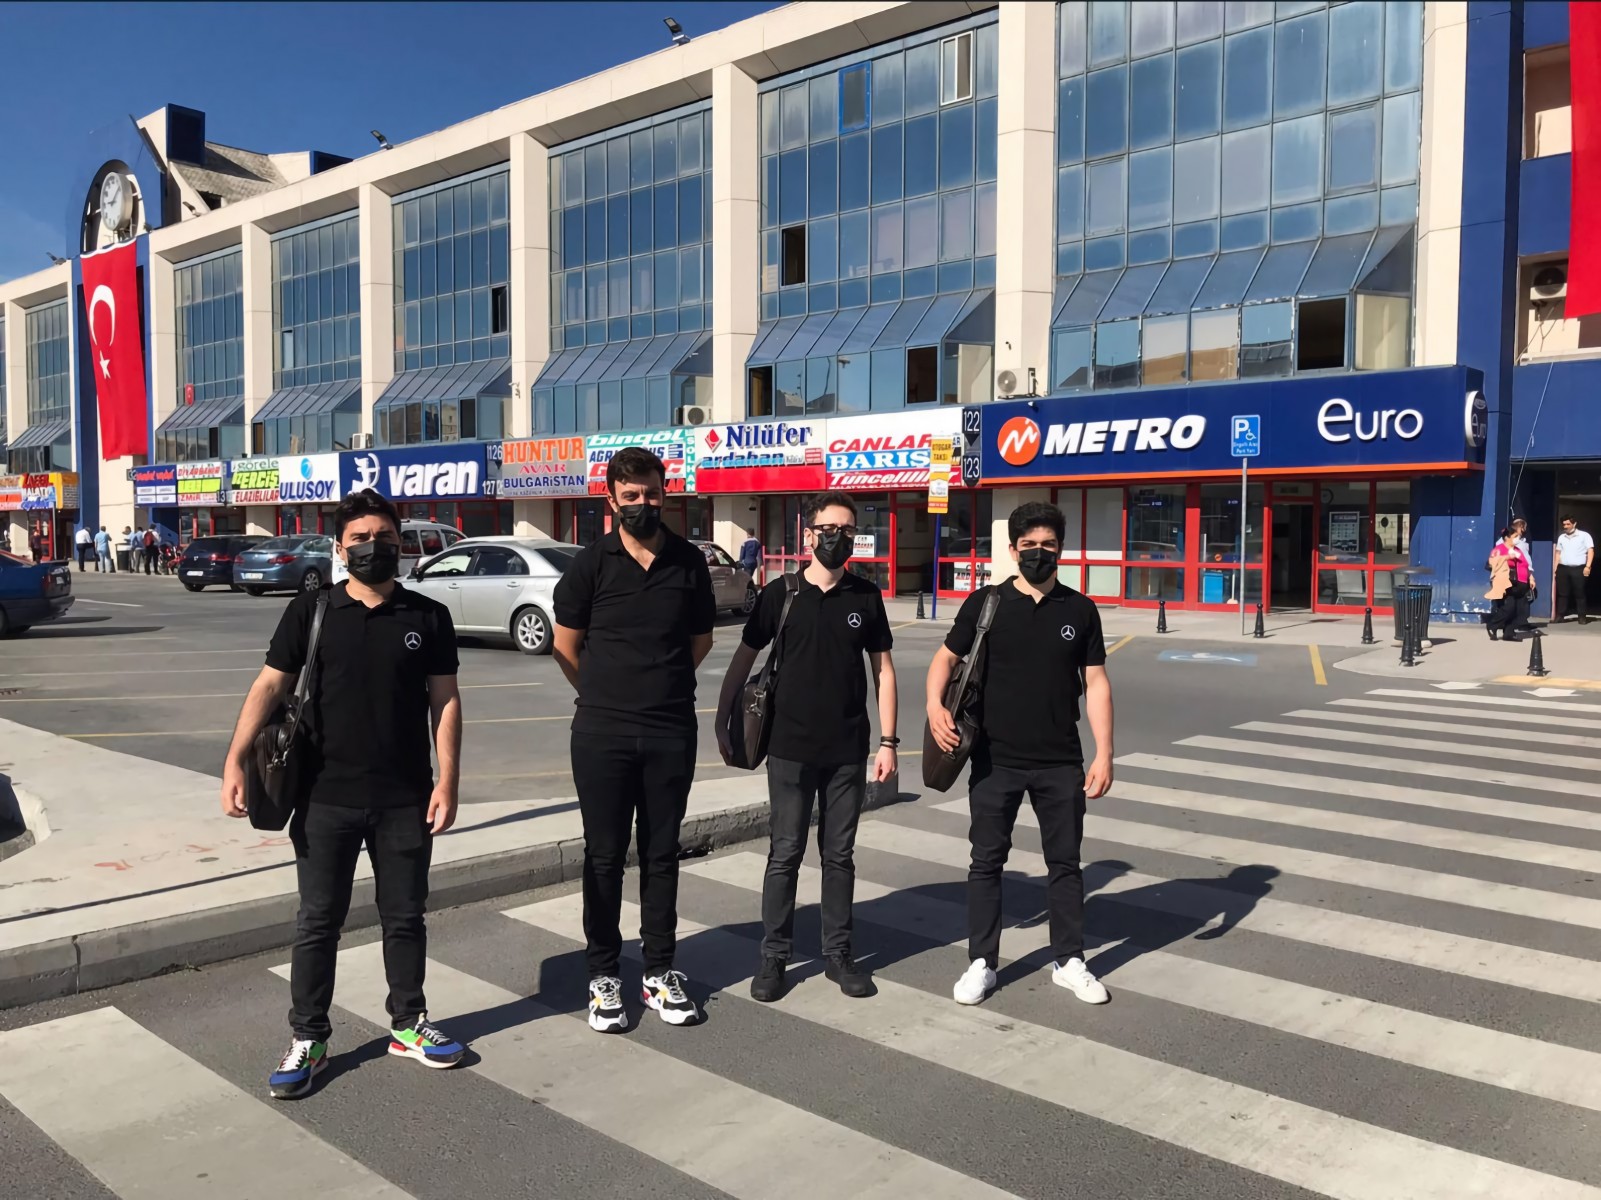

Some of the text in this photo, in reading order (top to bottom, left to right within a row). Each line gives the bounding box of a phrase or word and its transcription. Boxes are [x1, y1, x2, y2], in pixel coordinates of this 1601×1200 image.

[964, 411, 980, 431] 122
[1234, 418, 1250, 439] P
[1317, 398, 1423, 442] euro
[726, 423, 812, 448] Nilüfer
[1043, 415, 1206, 456] METRO
[503, 437, 585, 464] HUNTUR
[388, 460, 479, 497] varan
[964, 457, 980, 478] 123
[279, 480, 337, 501] ULUSOY
